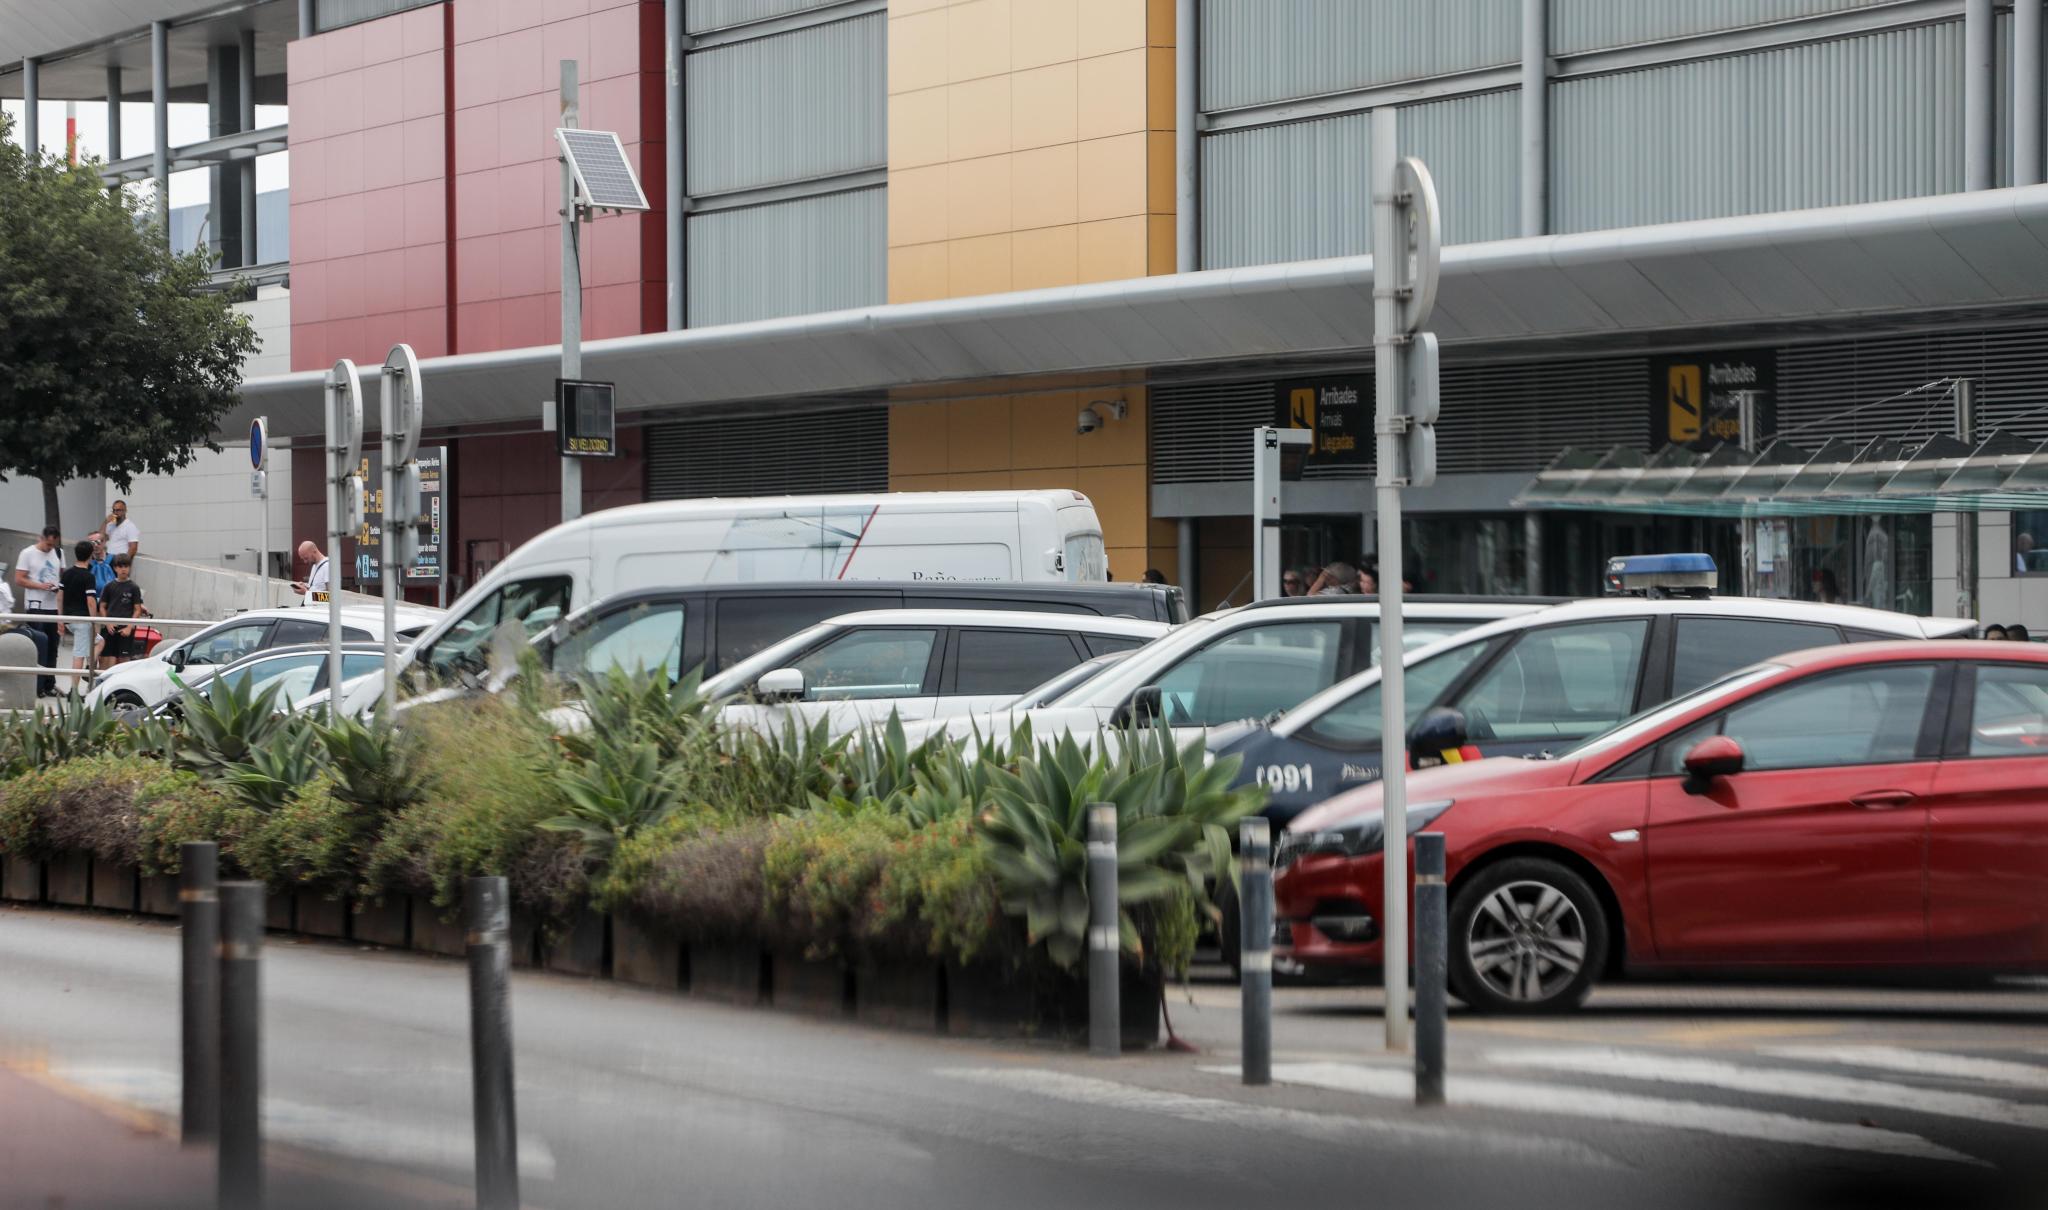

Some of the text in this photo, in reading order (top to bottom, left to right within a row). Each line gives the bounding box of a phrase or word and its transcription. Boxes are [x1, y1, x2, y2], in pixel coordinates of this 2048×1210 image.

[1320, 386, 1358, 404] Arribades
[1320, 433, 1356, 454] Llegadas
[317, 592, 329, 602] TAX
[1267, 763, 1313, 793] 091
